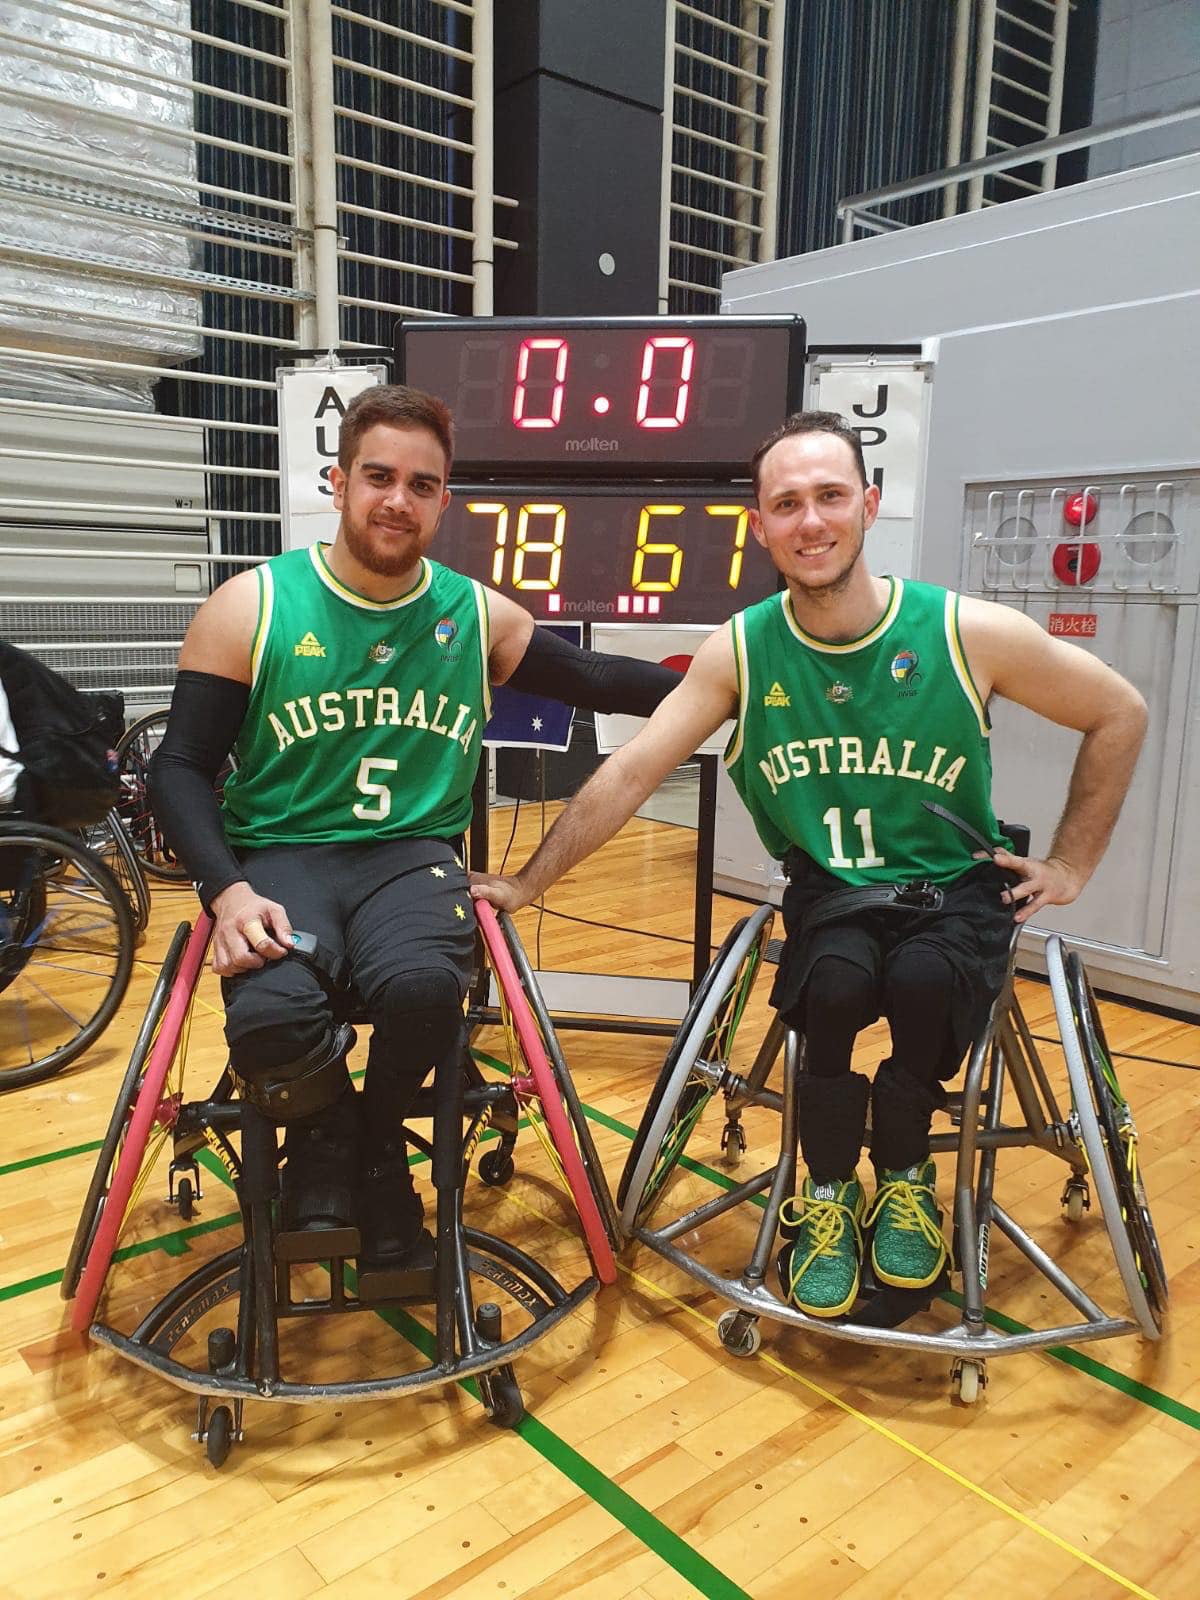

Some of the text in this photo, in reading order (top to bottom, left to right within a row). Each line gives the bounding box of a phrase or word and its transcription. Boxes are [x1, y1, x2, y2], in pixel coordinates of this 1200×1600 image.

[512, 337, 695, 429] 0.0
[565, 437, 619, 452] molten
[466, 503, 567, 591] 78
[631, 504, 750, 592] 67
[563, 599, 615, 613] molten
[1050, 617, 1097, 633] 消火栓
[294, 645, 327, 658] PEAK
[267, 687, 477, 755] AUSTRALIA
[764, 695, 792, 707] PEAK
[352, 757, 399, 821] 5
[822, 807, 886, 869] 11
